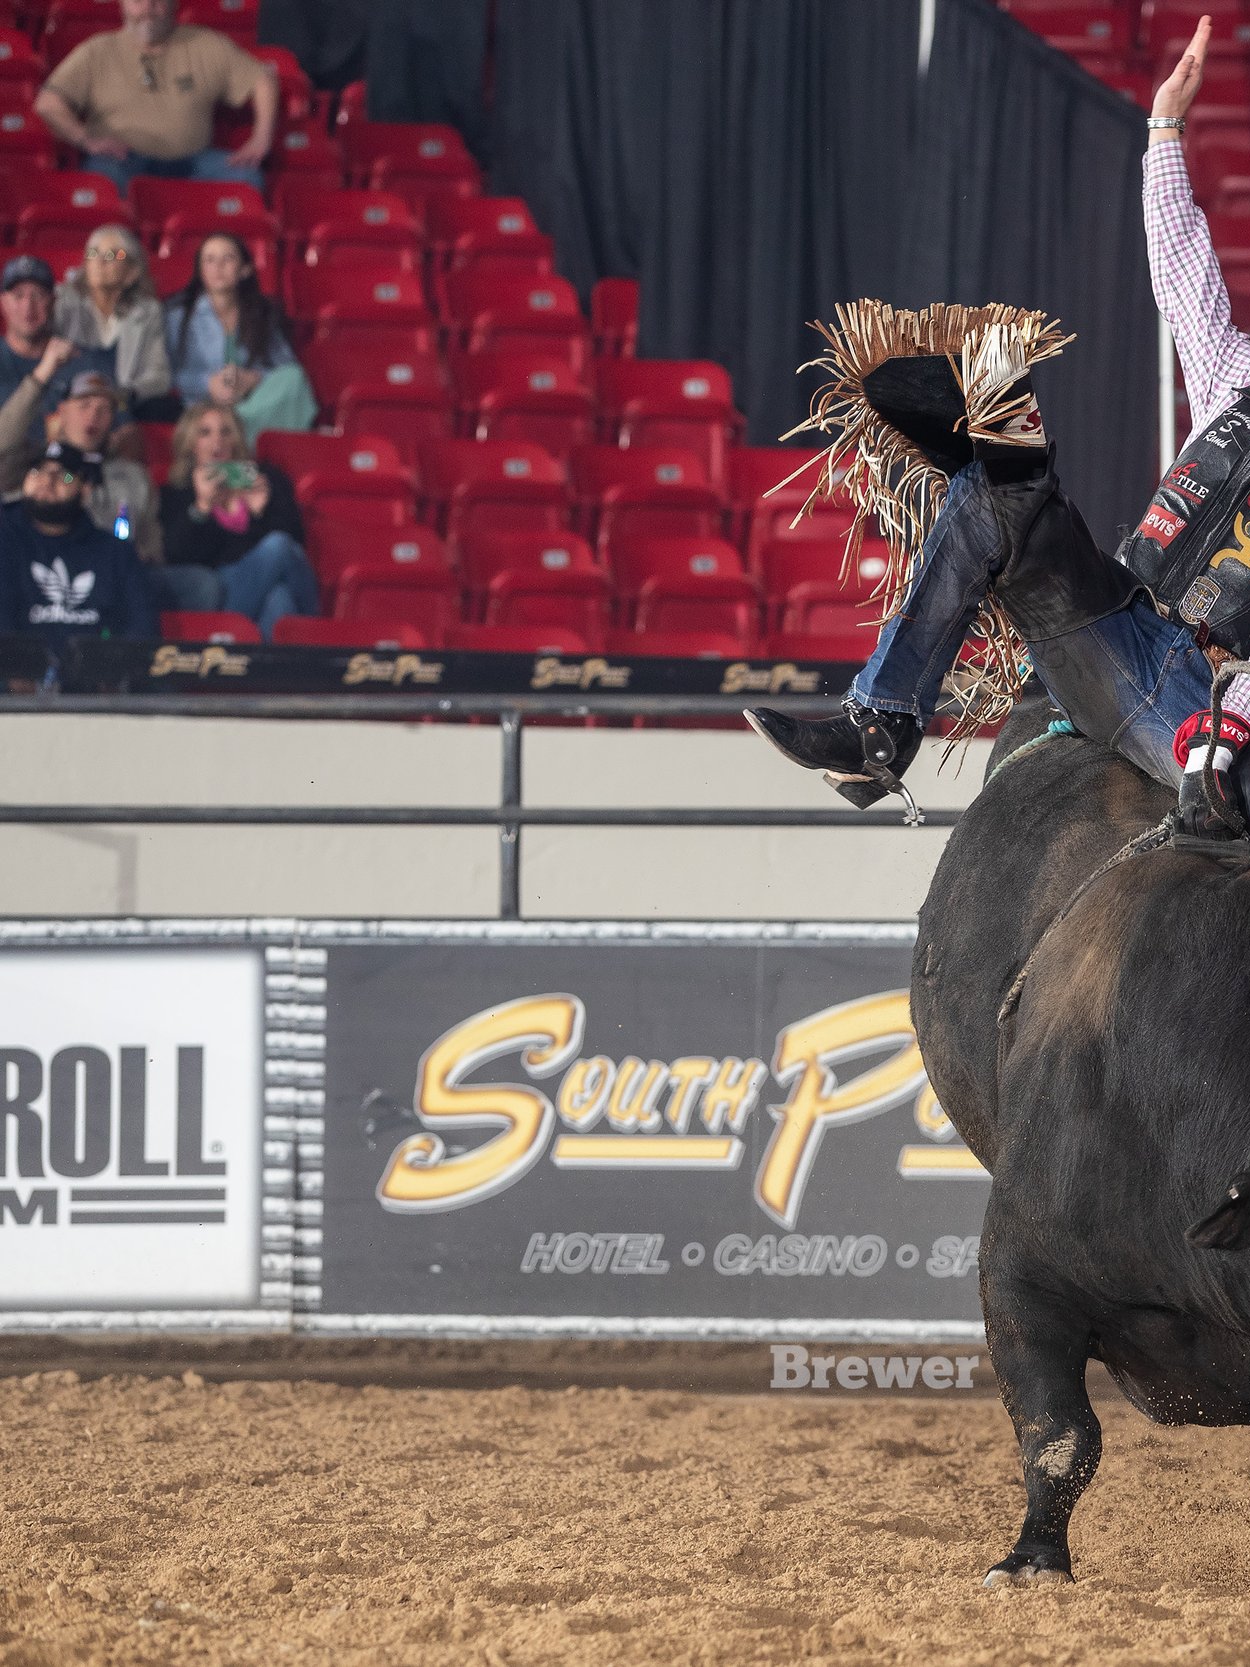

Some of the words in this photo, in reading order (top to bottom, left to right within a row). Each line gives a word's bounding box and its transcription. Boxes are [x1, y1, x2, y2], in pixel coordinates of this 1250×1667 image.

[1202, 430, 1232, 449] Ranch
[1176, 474, 1210, 499] TILE
[375, 991, 768, 1214] SOUTH
[520, 1231, 670, 1276] HOTEL
[713, 1233, 890, 1278] CASINO
[925, 1234, 981, 1278] SP
